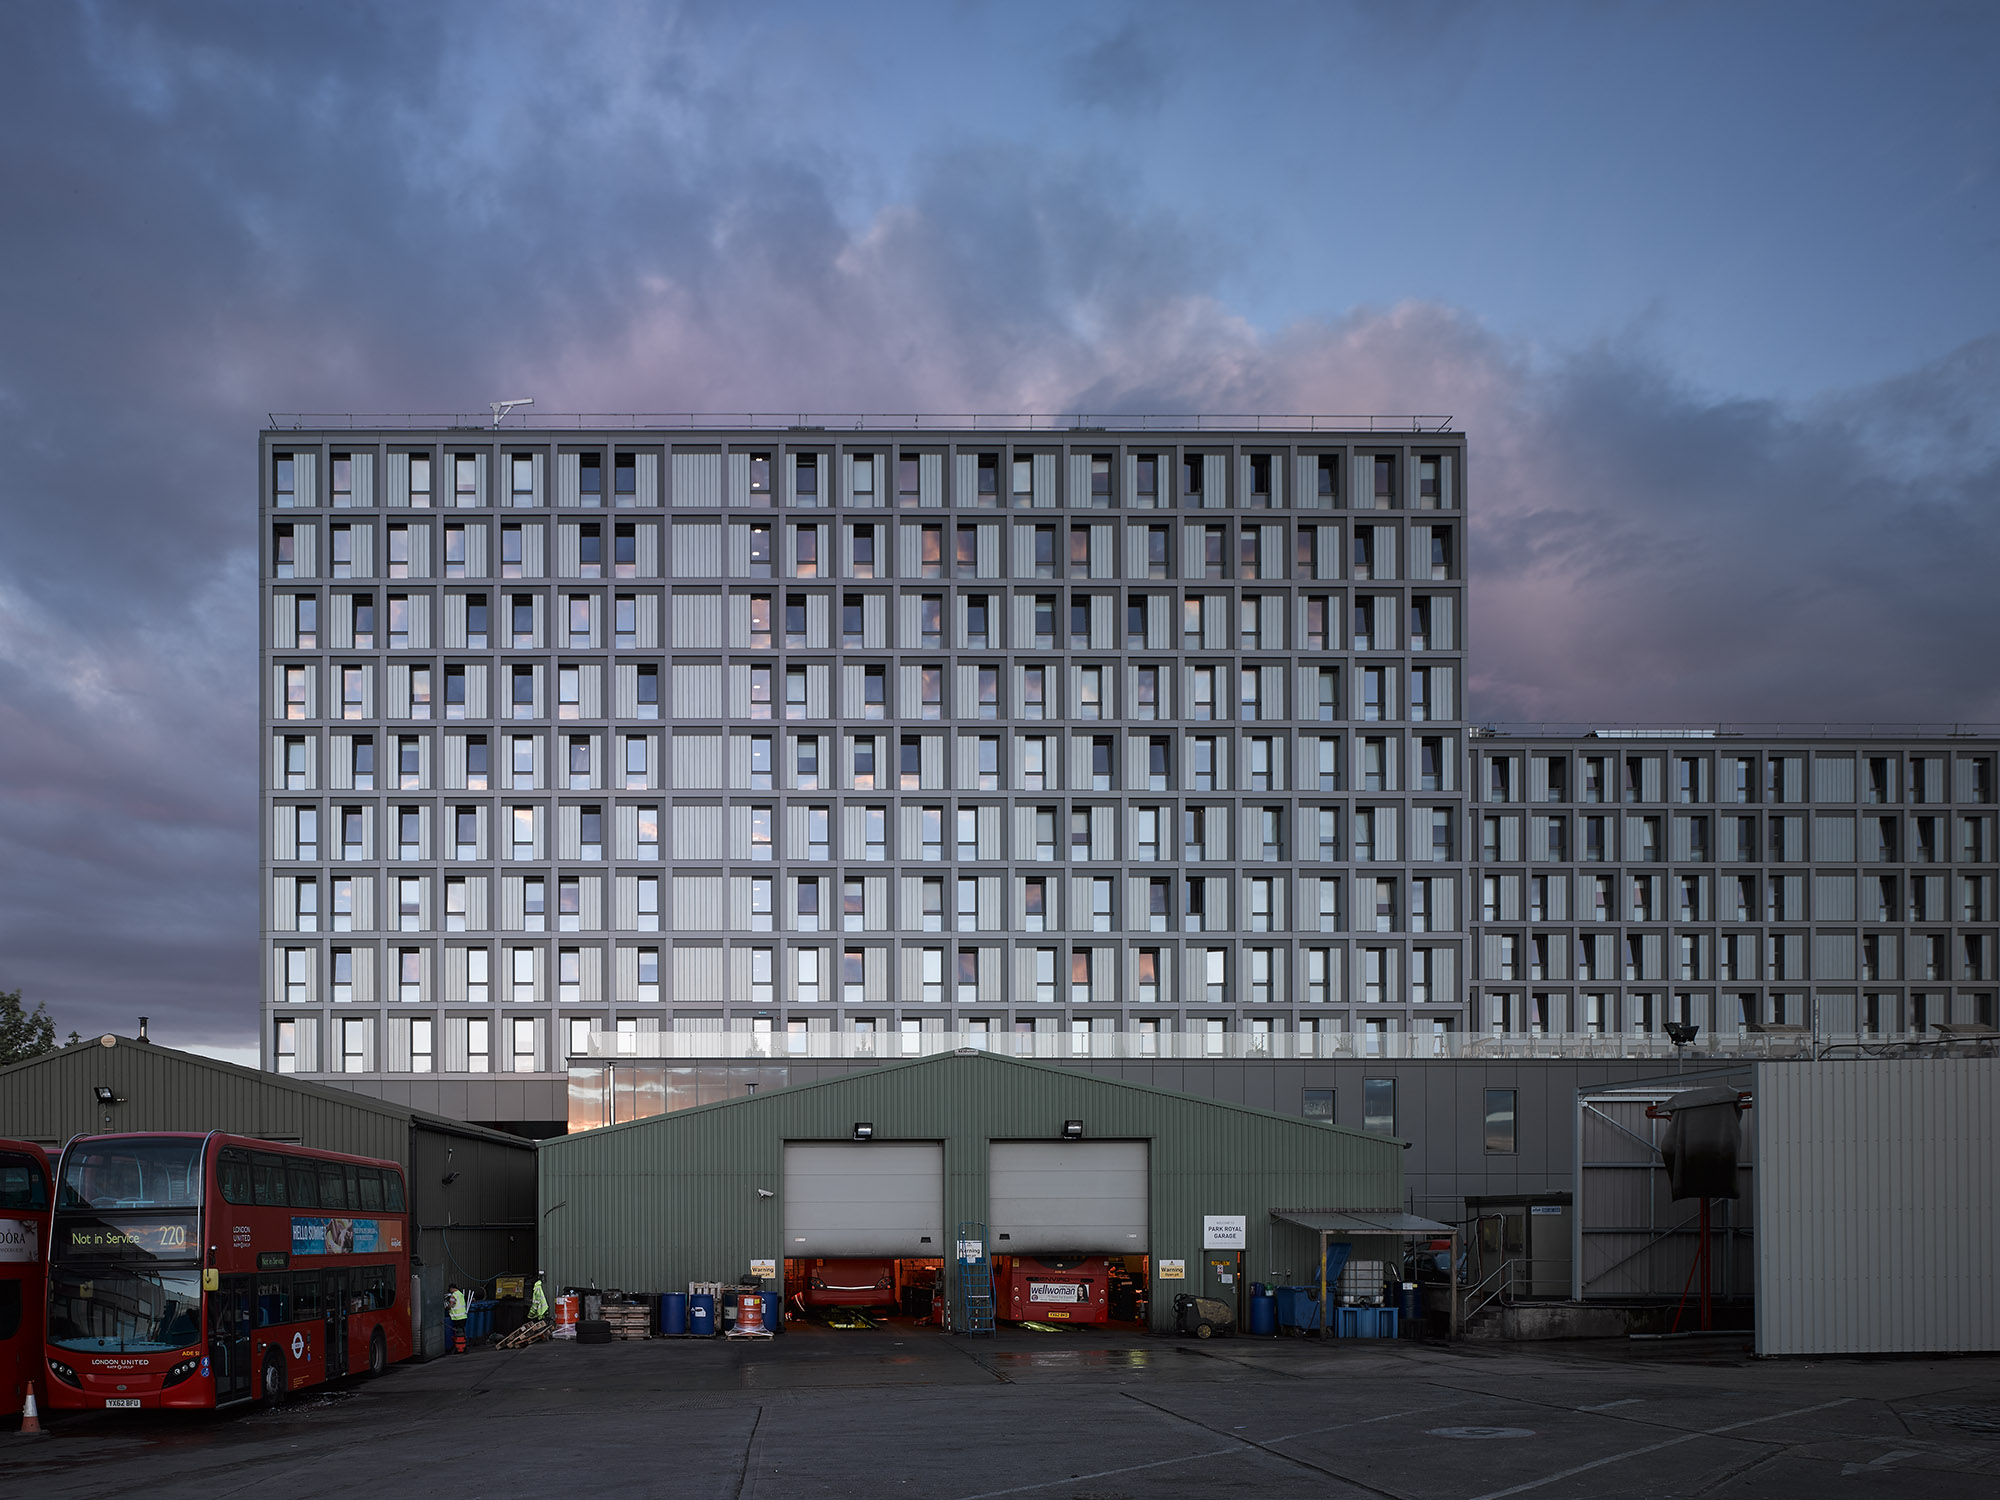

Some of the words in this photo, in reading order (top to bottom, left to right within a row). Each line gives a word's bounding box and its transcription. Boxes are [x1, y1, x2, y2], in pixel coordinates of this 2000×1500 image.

[72, 1232, 91, 1245] Not
[94, 1233, 103, 1245] in
[106, 1232, 140, 1245] Service
[159, 1226, 185, 1246] 220
[1031, 1285, 1076, 1295] wellwoman
[108, 1399, 125, 1407] YX62
